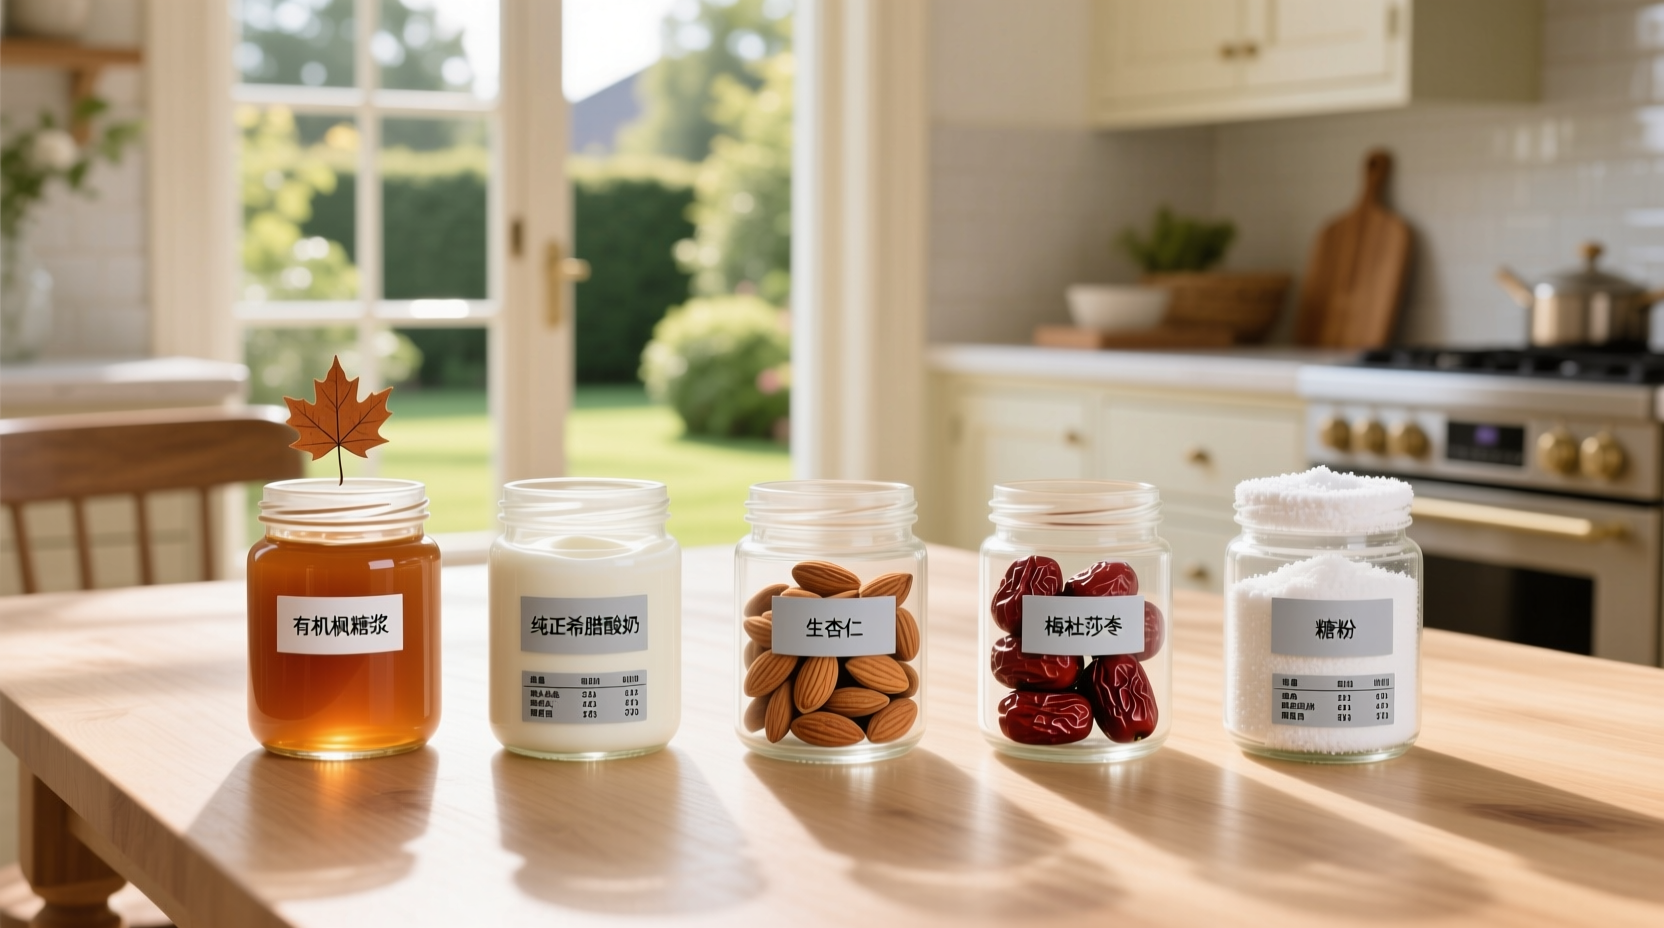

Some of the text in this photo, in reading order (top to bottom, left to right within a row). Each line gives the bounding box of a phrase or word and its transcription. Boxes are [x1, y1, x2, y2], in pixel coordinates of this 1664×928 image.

[530, 614, 640, 637] 纯正希腊酸奶
[805, 617, 864, 639] 生杏仁
[1315, 618, 1357, 640] 糖粉
